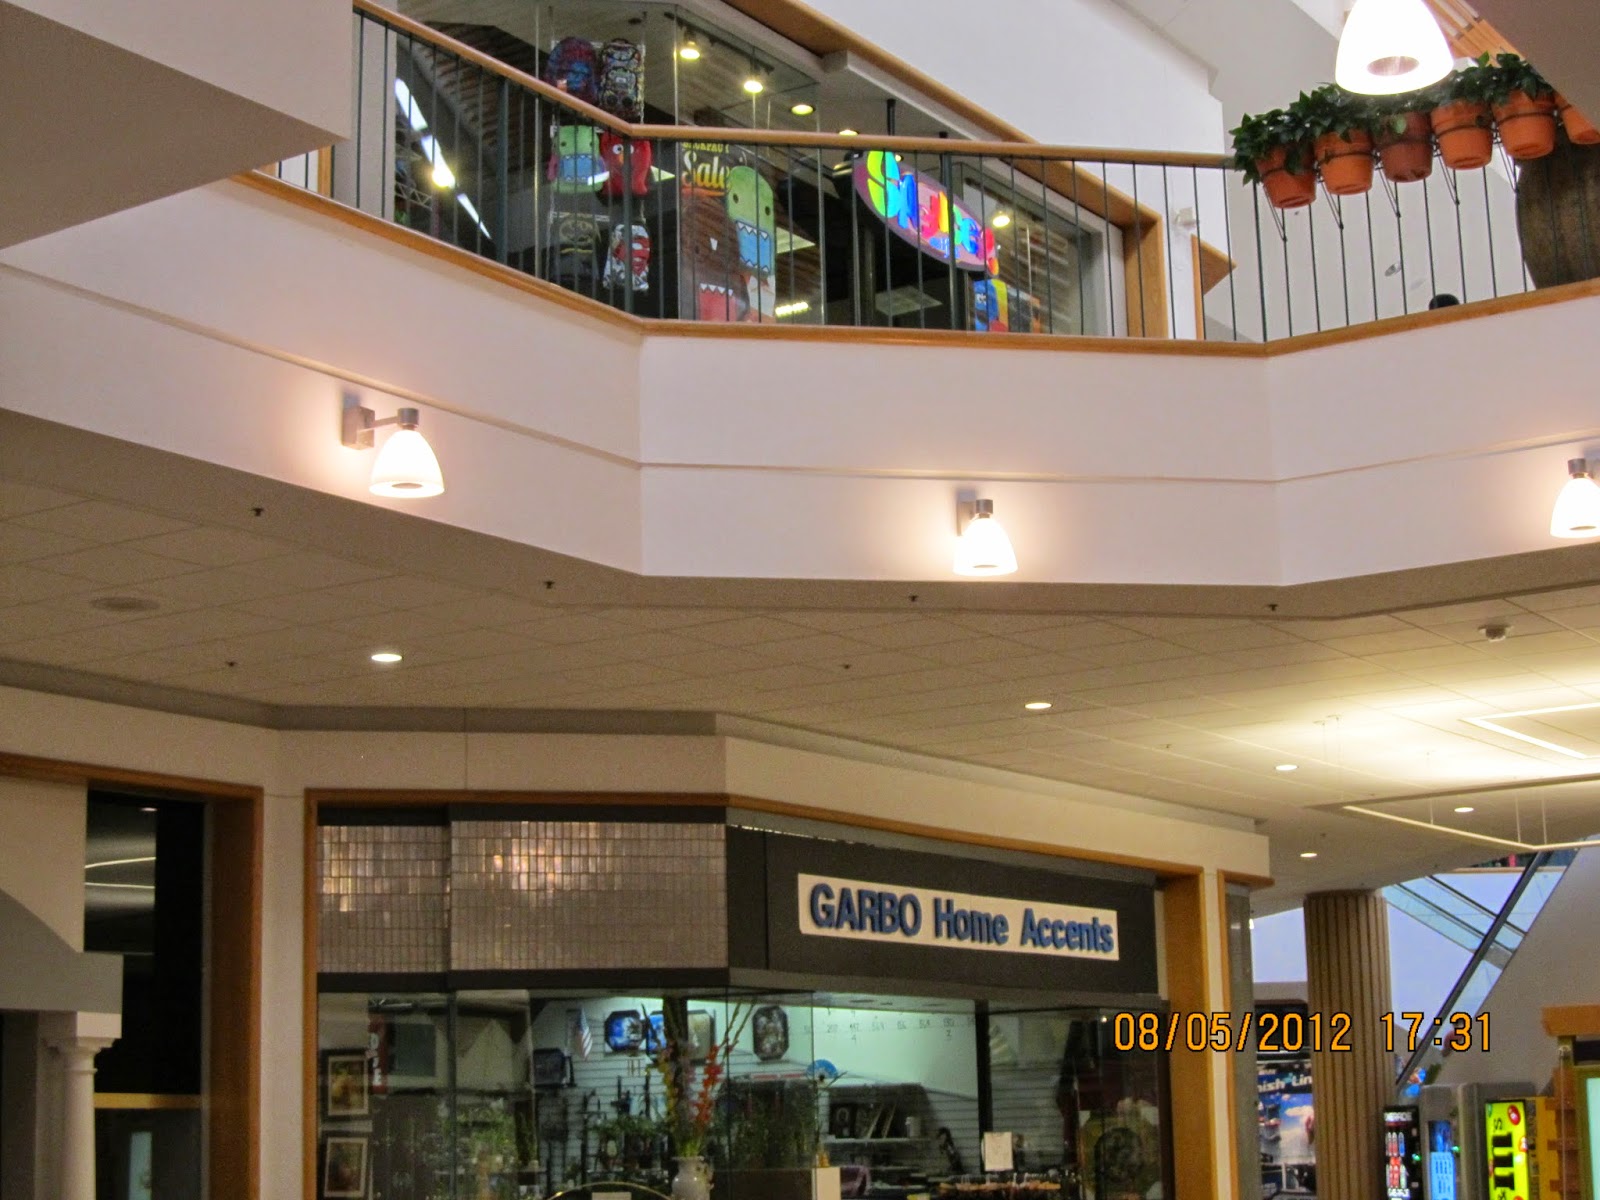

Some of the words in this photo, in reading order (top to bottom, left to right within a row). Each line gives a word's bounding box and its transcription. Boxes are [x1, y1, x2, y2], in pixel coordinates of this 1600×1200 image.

[681, 151, 732, 191] Sale
[809, 882, 922, 937] GARBO
[933, 897, 1009, 946] Home
[1019, 907, 1115, 953] Accents
